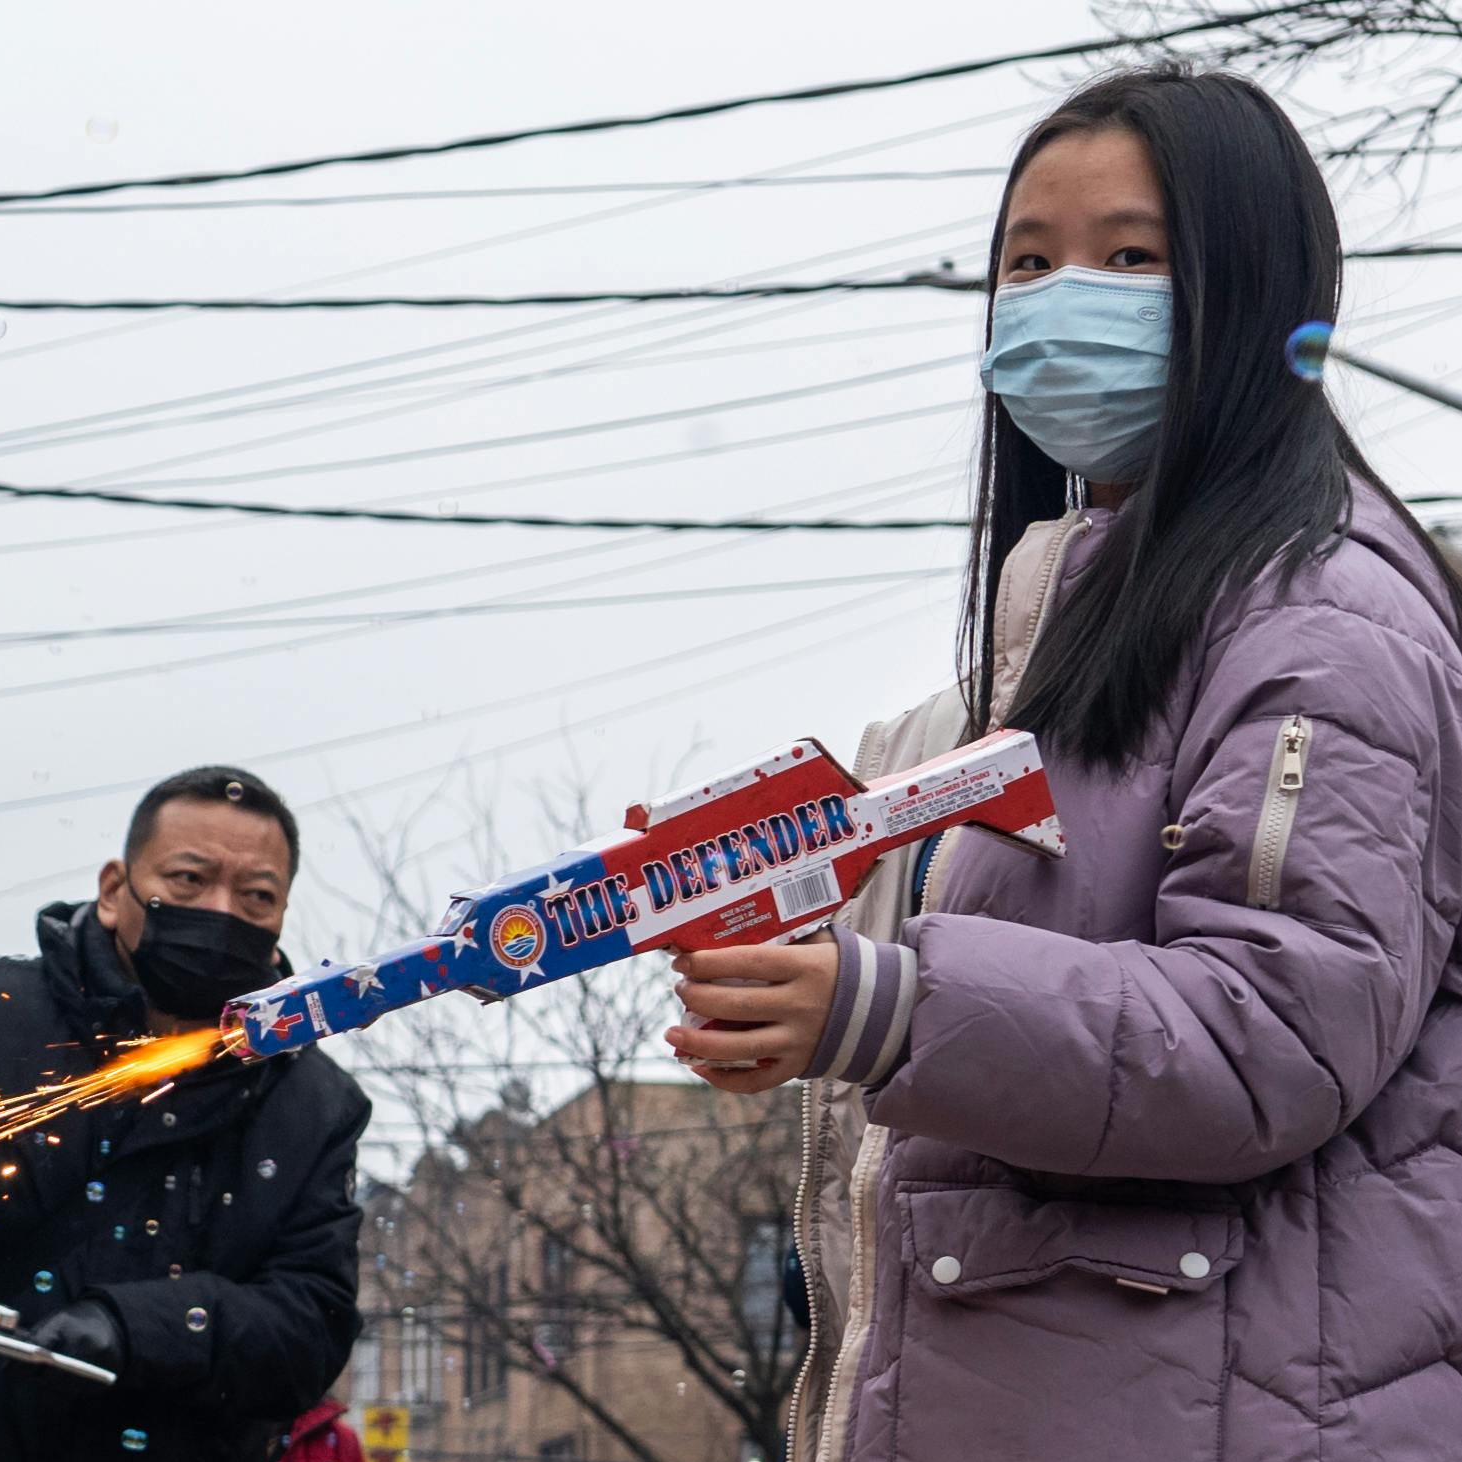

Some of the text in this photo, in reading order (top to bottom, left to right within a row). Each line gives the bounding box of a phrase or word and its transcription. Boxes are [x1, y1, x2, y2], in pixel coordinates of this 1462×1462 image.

[888, 771, 990, 814] CAUTION EMITS SHOWERS OF SPARKS
[545, 874, 639, 946] THE
[641, 794, 856, 912] DEFENDER
[714, 912, 772, 940] CONSUMER FIREWORKS
[719, 909, 734, 920] MADE
[739, 900, 757, 911] CHINA
